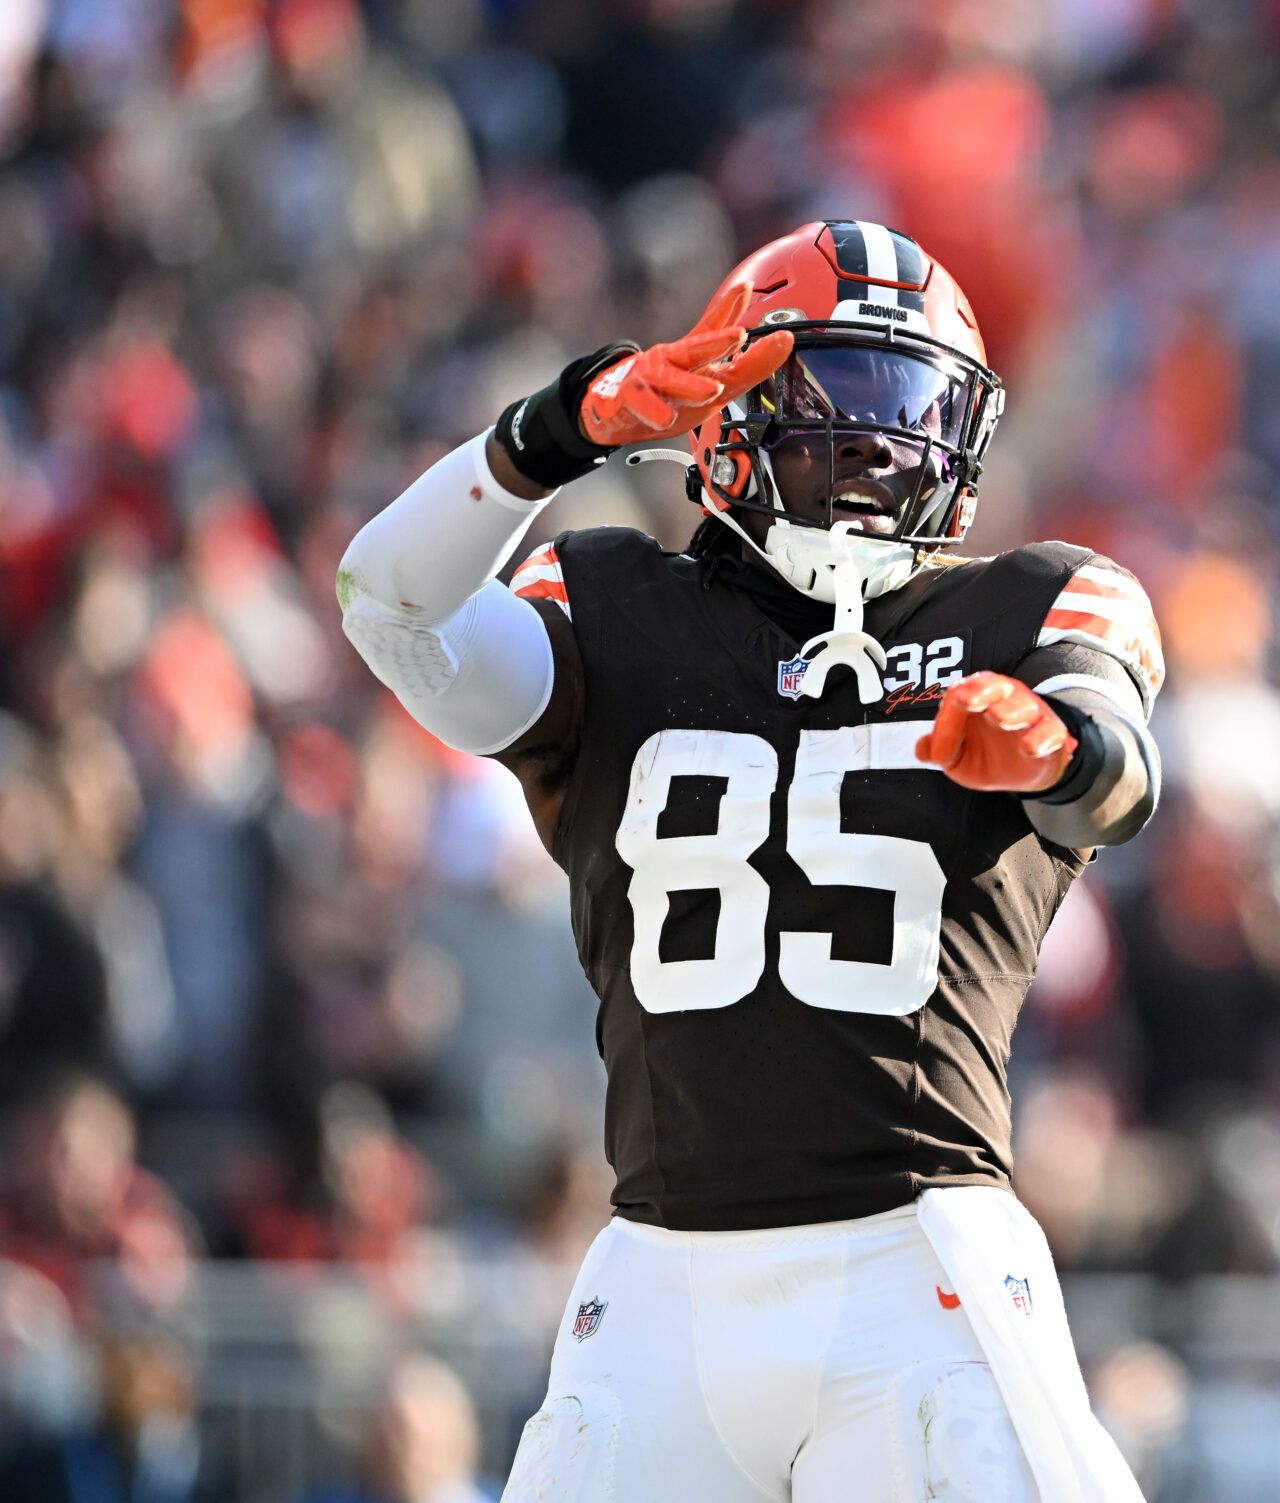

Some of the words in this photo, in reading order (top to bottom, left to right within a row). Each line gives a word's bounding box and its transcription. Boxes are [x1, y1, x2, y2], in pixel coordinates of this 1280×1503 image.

[859, 303, 908, 322] BROWNS
[883, 636, 964, 693] 32
[783, 673, 805, 691] NF
[615, 720, 948, 1017] 85
[575, 1316, 595, 1334] NFL
